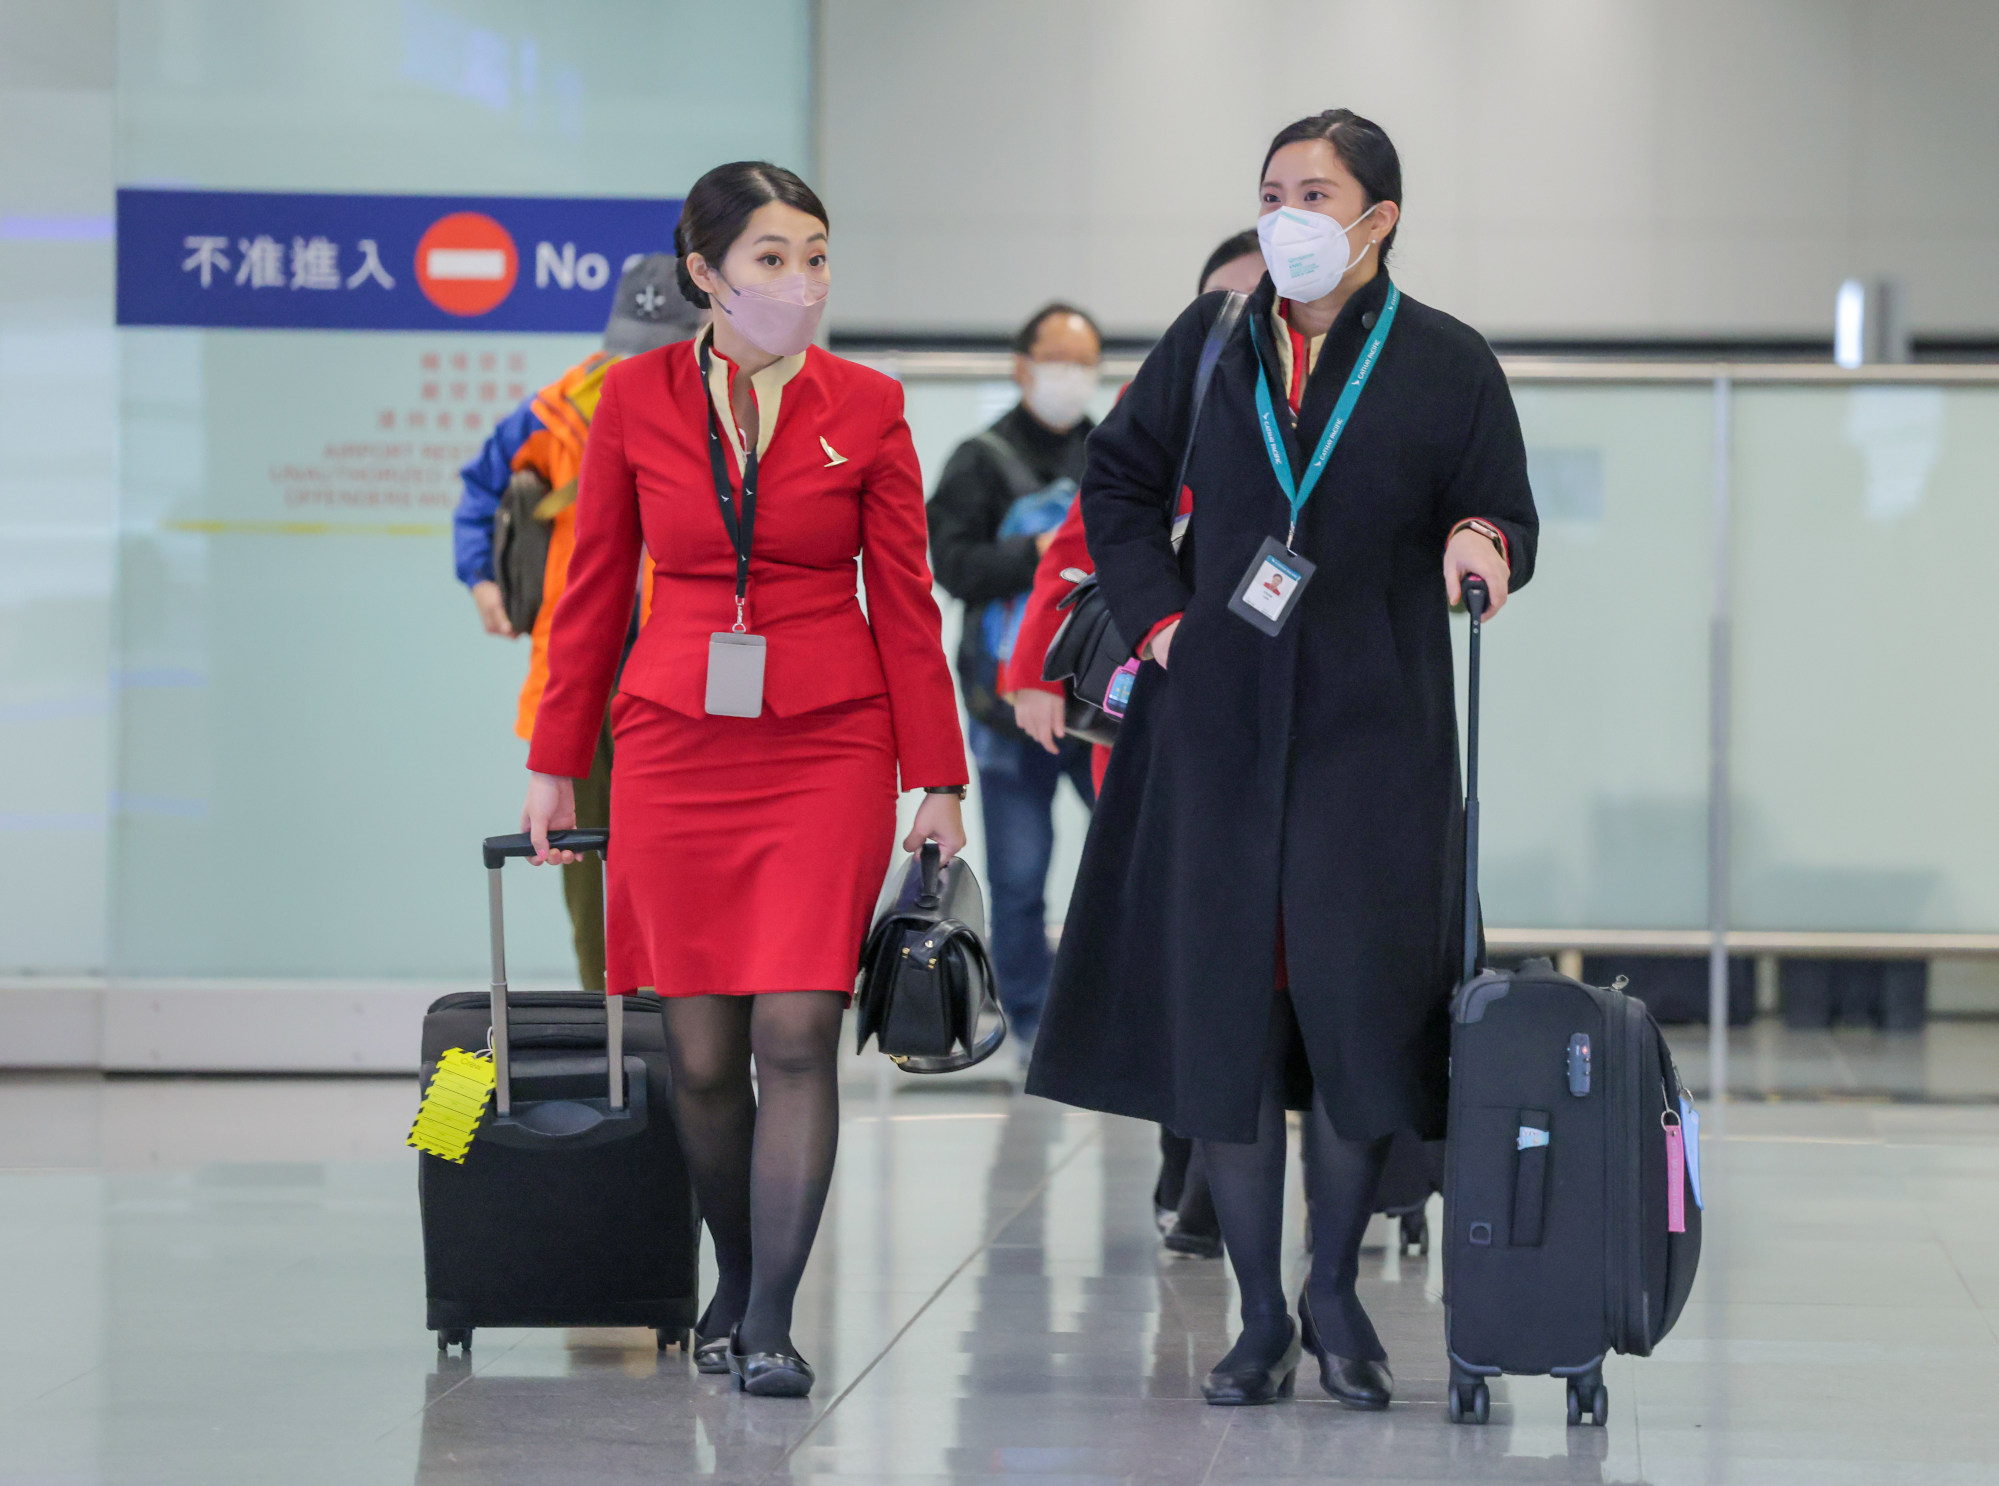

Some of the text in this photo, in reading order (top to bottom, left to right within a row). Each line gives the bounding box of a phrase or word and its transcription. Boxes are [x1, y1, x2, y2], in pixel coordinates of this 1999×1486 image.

[181, 234, 396, 290] 不准進入
[535, 240, 610, 291] No
[1357, 339, 1380, 380] CATHAY PACIFIC
[1319, 417, 1343, 461] CATHAY PACIFIC
